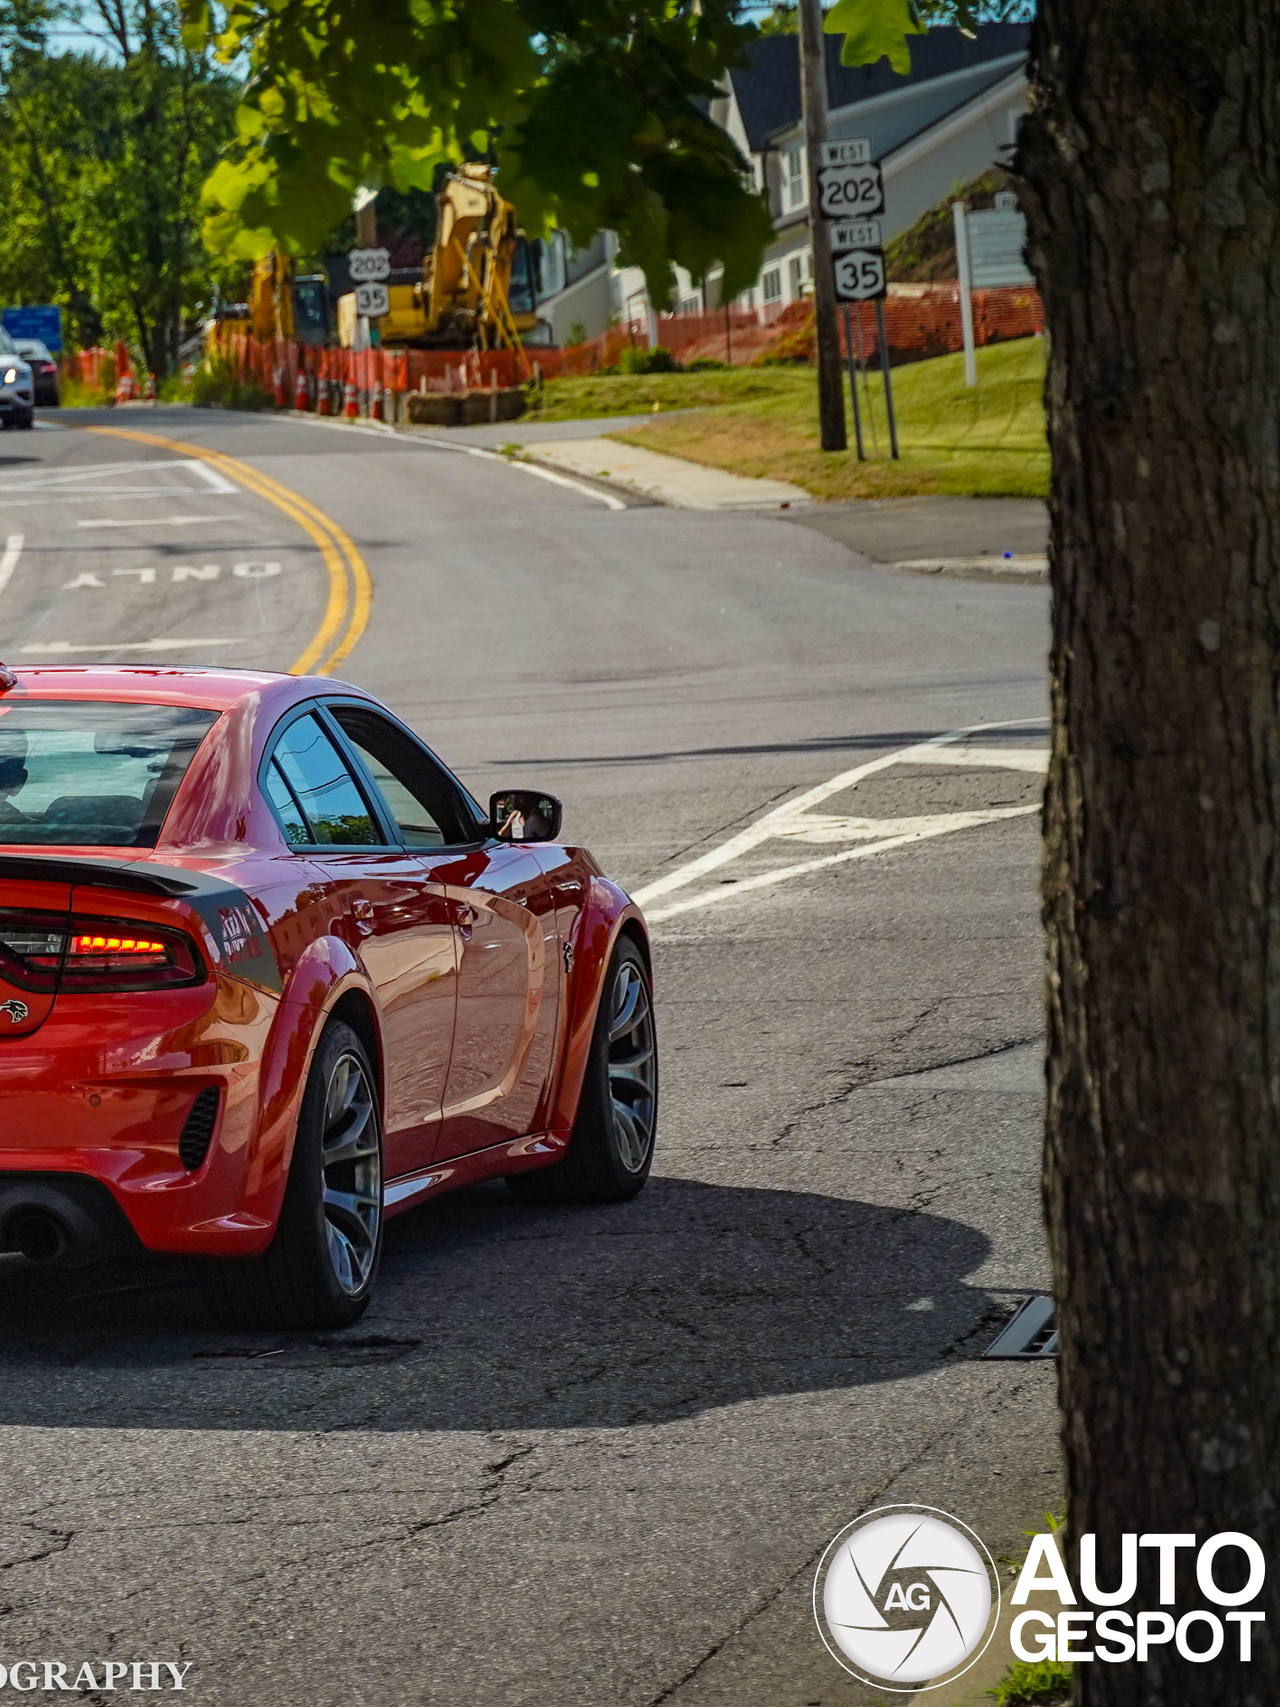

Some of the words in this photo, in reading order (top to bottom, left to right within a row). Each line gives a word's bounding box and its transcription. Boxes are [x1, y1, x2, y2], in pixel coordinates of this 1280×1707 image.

[828, 143, 864, 161] WEST
[827, 178, 875, 205] 202
[836, 226, 873, 244] WEST
[353, 256, 388, 275] 202
[842, 261, 880, 291] 35
[360, 289, 386, 309] 35
[60, 561, 282, 590] ONLY
